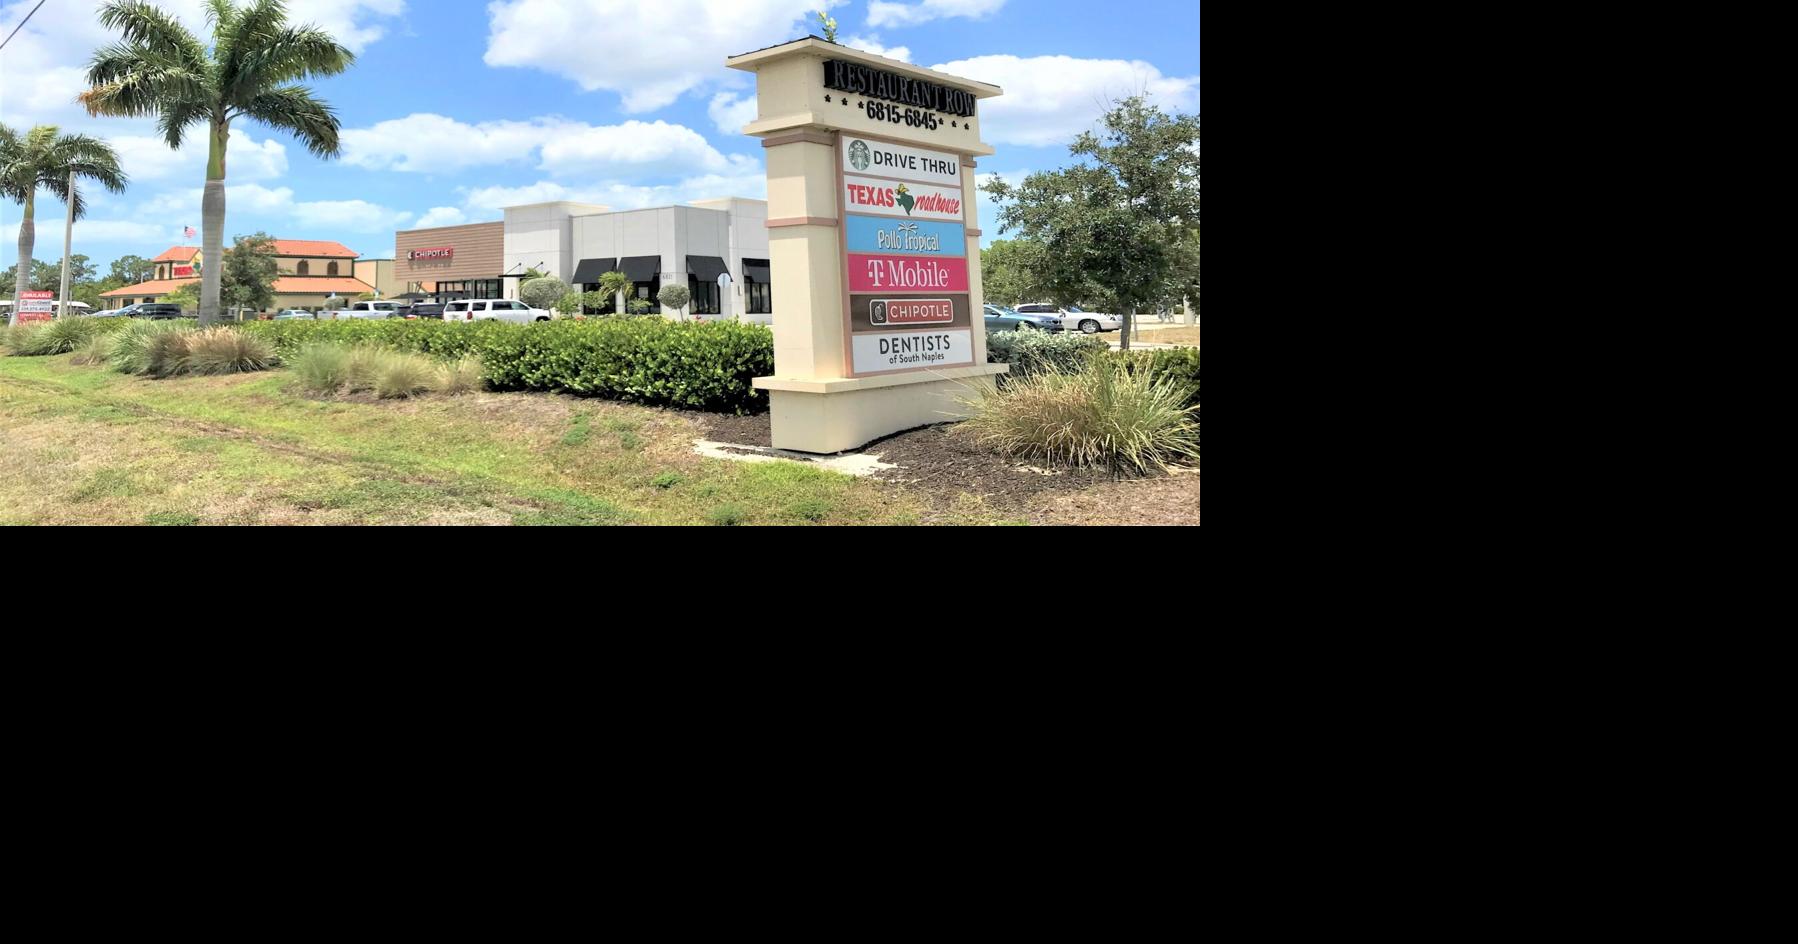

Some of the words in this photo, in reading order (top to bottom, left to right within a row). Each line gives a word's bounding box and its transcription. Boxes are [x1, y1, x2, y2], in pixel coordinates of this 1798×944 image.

[831, 60, 942, 111] RESTAURANT
[944, 86, 976, 117] ROW
[866, 100, 938, 131] 6815-6845
[873, 150, 917, 170] DRIVE
[920, 157, 956, 176] THRU
[847, 184, 895, 208] TEXAS
[913, 192, 960, 215] roadhouse
[877, 229, 901, 250] Pollo
[903, 228, 940, 252] Tropical
[415, 248, 450, 258] CHIPOTLE
[888, 259, 949, 287] Mobile
[890, 304, 950, 318] CHIPOTLE
[879, 335, 950, 355] DENTISTS
[889, 355, 898, 364] of
[899, 353, 920, 364] South
[921, 352, 945, 363] Naples
